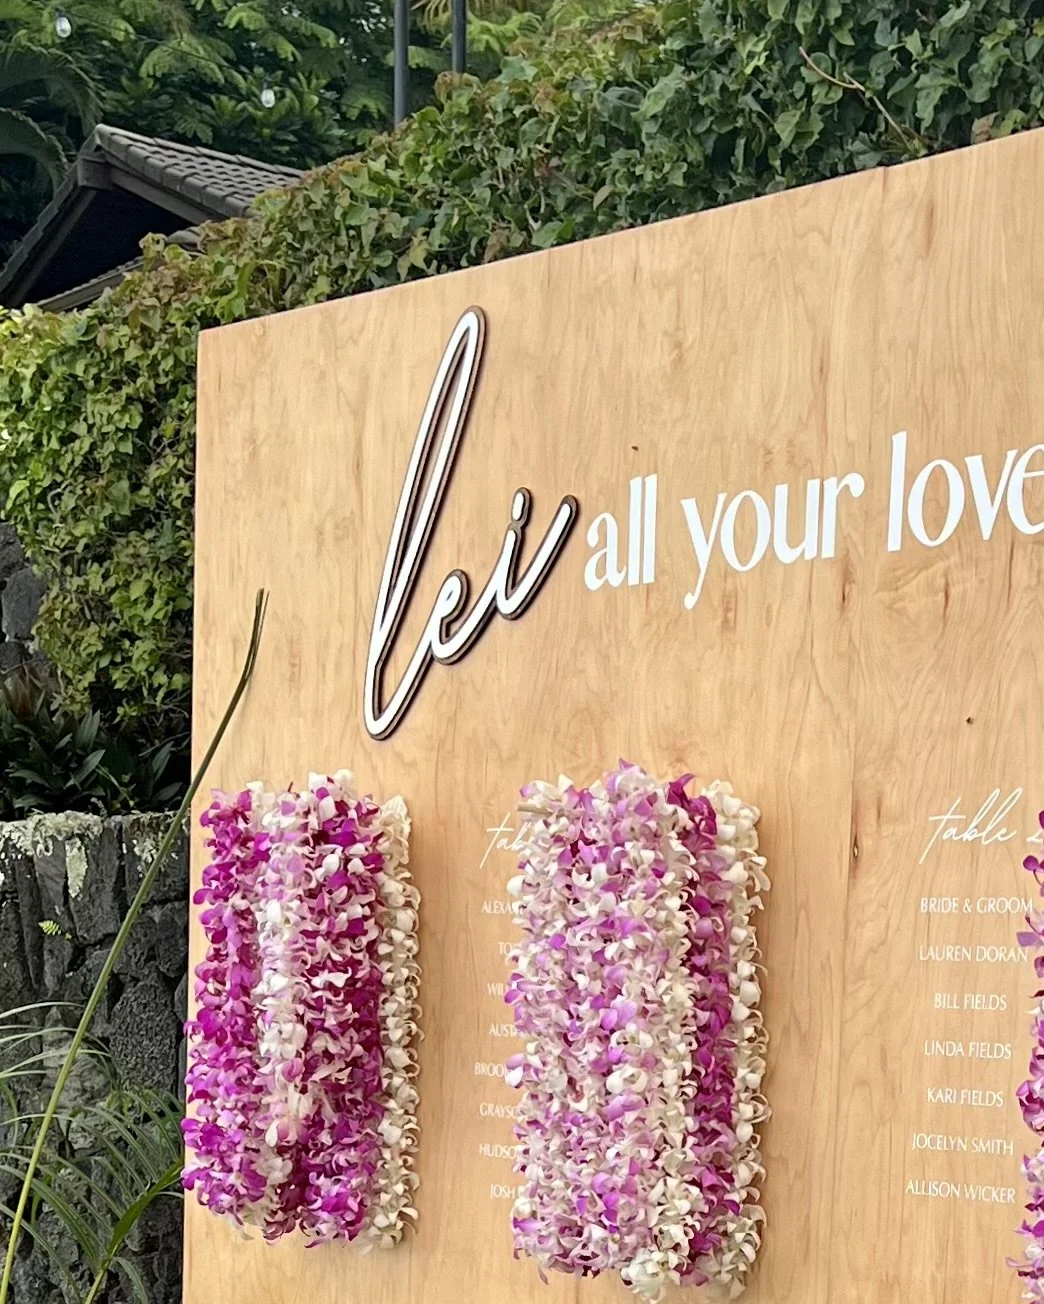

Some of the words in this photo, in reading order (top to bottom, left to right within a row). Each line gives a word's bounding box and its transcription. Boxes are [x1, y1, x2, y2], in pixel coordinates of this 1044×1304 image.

[363, 305, 579, 740] lei
[583, 473, 659, 591] all
[680, 472, 865, 610] your
[919, 787, 1023, 864] table
[920, 897, 958, 913] BRIDE
[962, 897, 972, 913] &
[976, 897, 1034, 914] GROOM
[919, 945, 973, 961] LAUREN
[975, 945, 1030, 962] DORAN
[934, 993, 959, 1009] BILL
[963, 994, 1007, 1011] FIELDS
[924, 1040, 964, 1057] LINDA
[968, 1041, 1012, 1060] FIELDS
[475, 1061, 507, 1077] BROO
[927, 1087, 956, 1104] KARI
[960, 1089, 1004, 1107] FIELDS
[480, 1143, 517, 1160] HUDSO
[912, 1132, 968, 1151] JOCELYN
[972, 1137, 1014, 1156] SMITH
[905, 1179, 960, 1197] ALLISON
[964, 1184, 1016, 1204] WICKER
